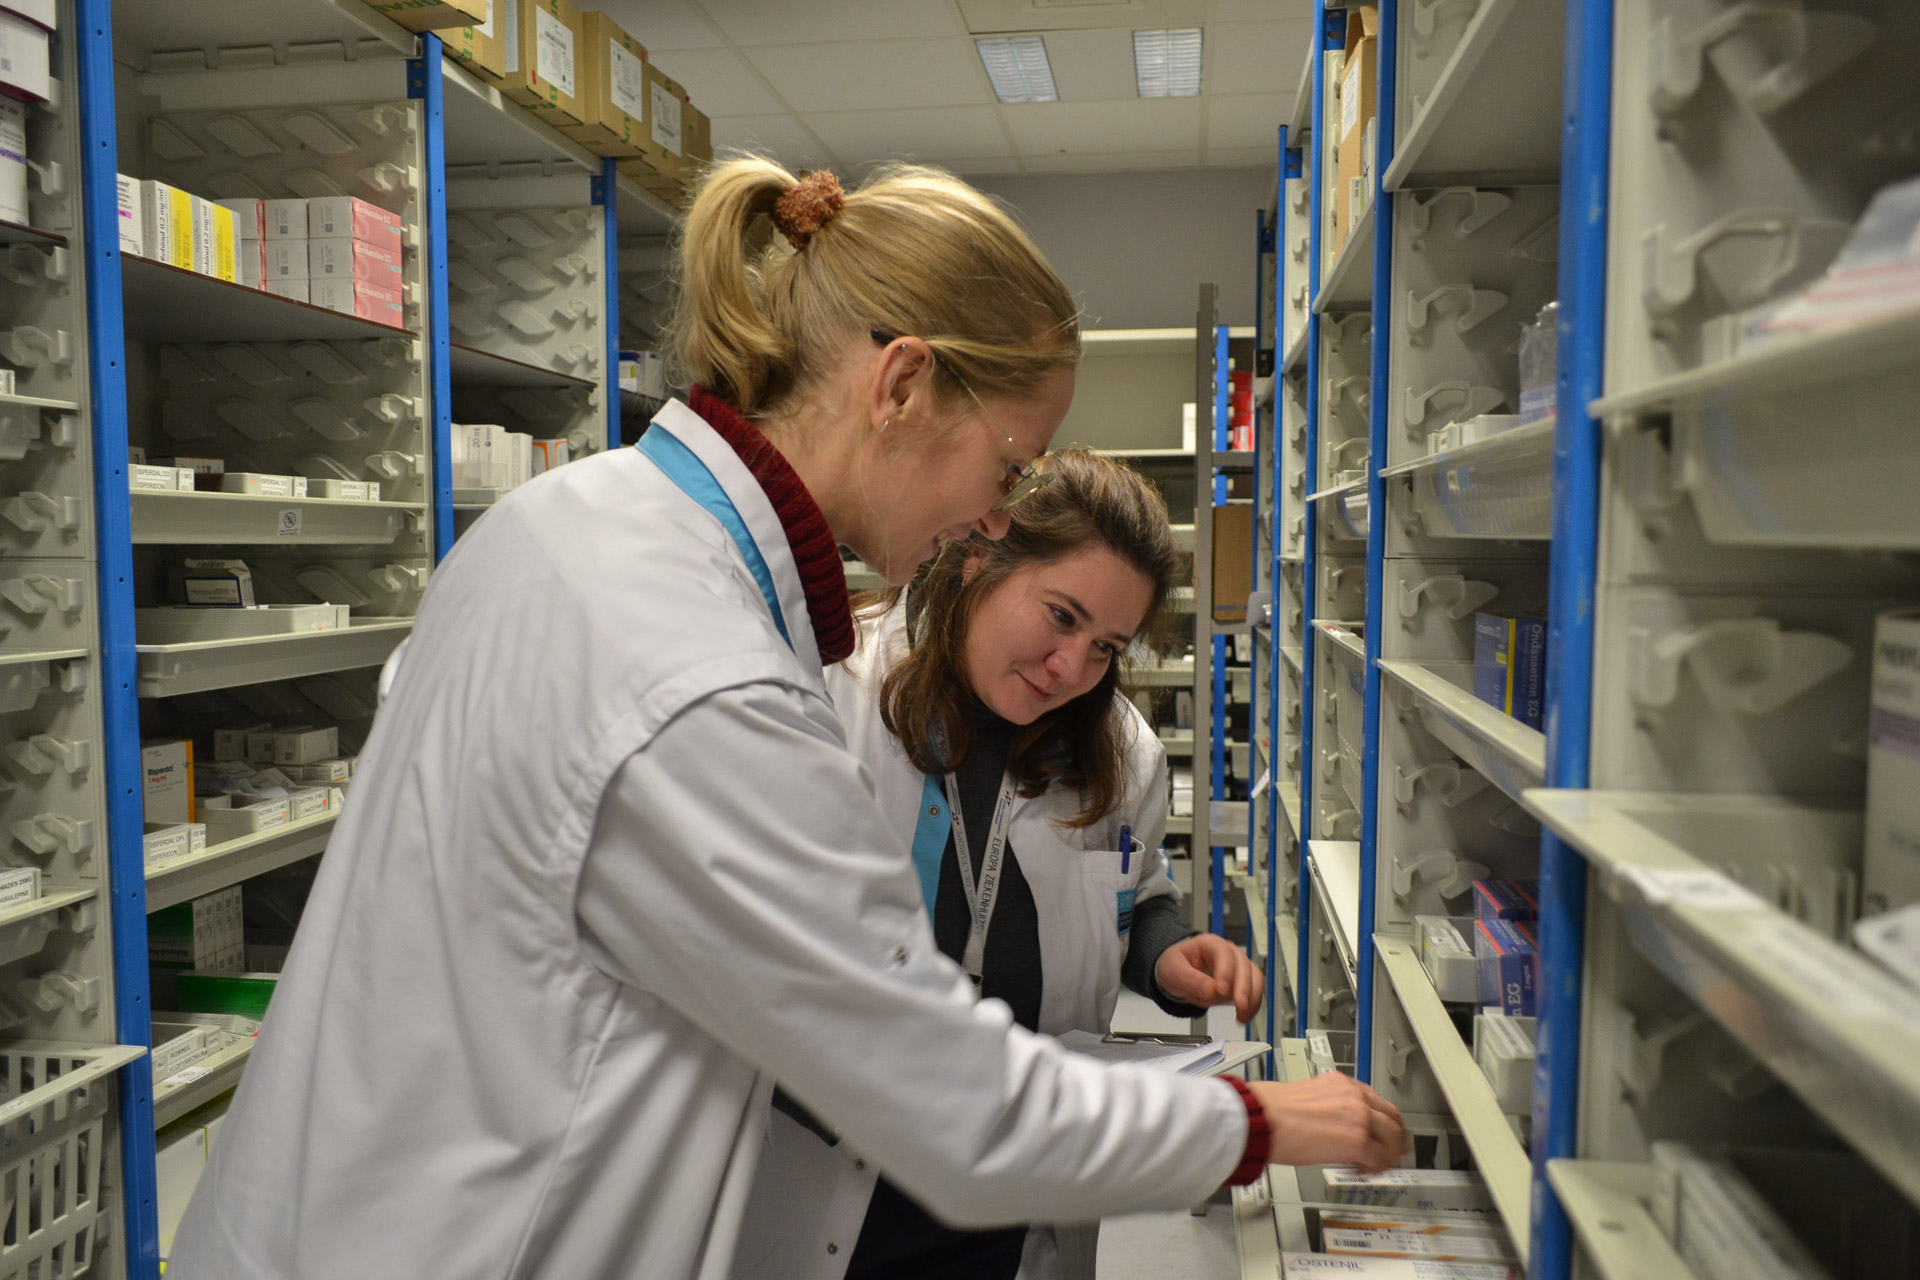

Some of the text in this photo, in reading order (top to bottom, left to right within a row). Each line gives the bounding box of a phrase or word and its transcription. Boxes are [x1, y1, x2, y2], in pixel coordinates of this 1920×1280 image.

[472, 437, 480, 448] 20
[1527, 623, 1542, 718] Ondansetron EG
[148, 764, 173, 777] Risperdal
[989, 837, 1001, 872] EUROPA
[1507, 982, 1521, 1005] EG
[1298, 1257, 1360, 1269] OSTENIL
